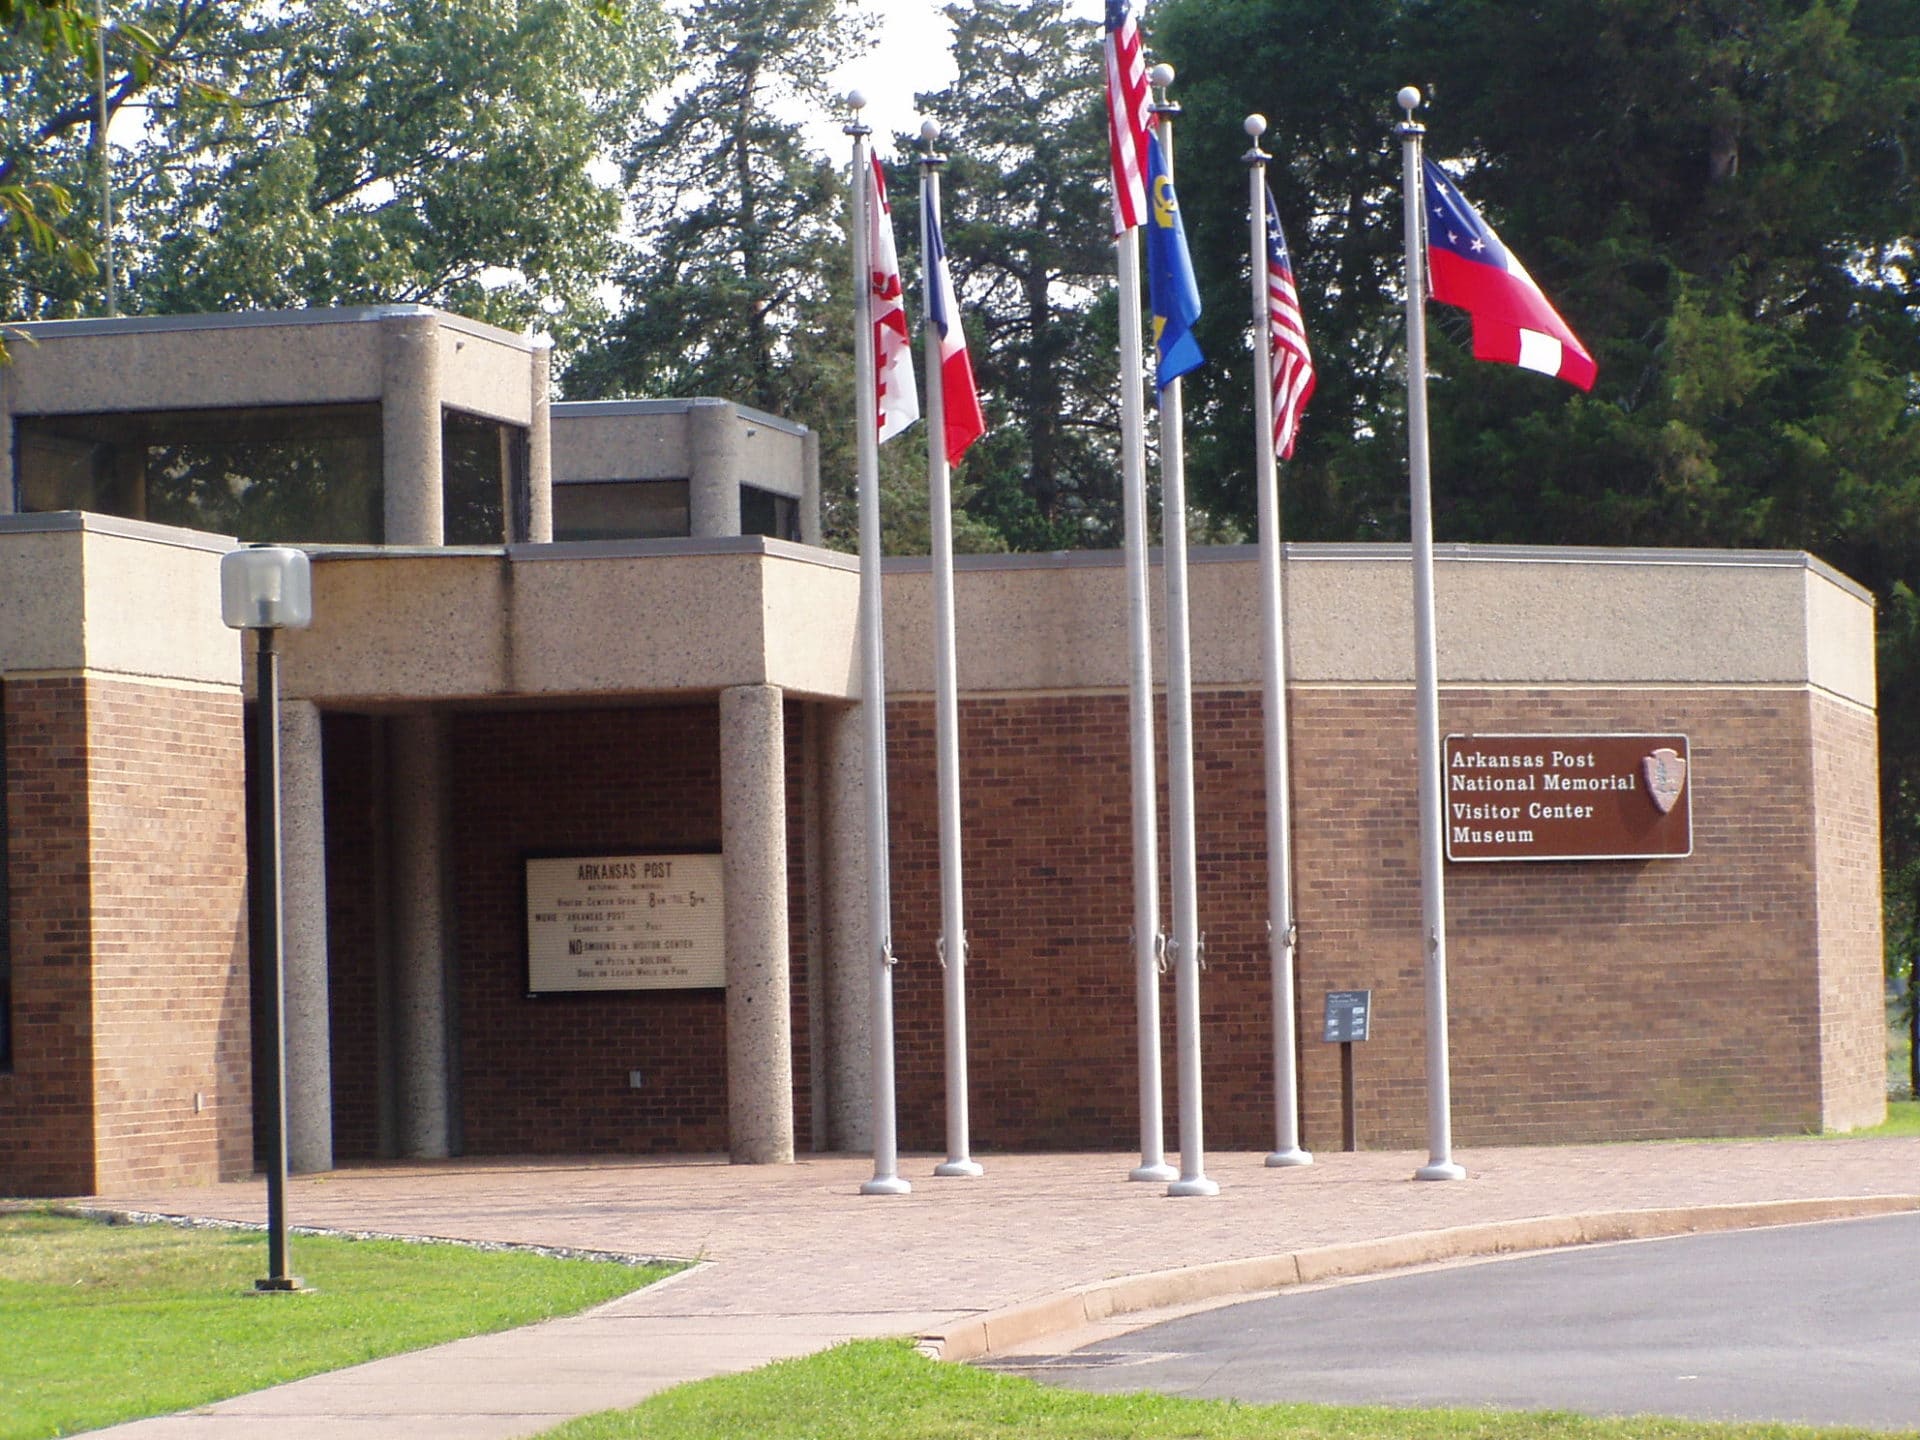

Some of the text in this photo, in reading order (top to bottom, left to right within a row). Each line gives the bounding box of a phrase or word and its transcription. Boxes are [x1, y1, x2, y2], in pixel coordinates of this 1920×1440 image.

[1451, 751, 1595, 768] Arkansas Post
[1451, 774, 1635, 791] National Memorial
[1452, 802, 1594, 820] Visitor Center
[1453, 827, 1534, 843] Museum
[578, 862, 673, 880] ARKANSAS POST
[568, 939, 582, 955] NO
